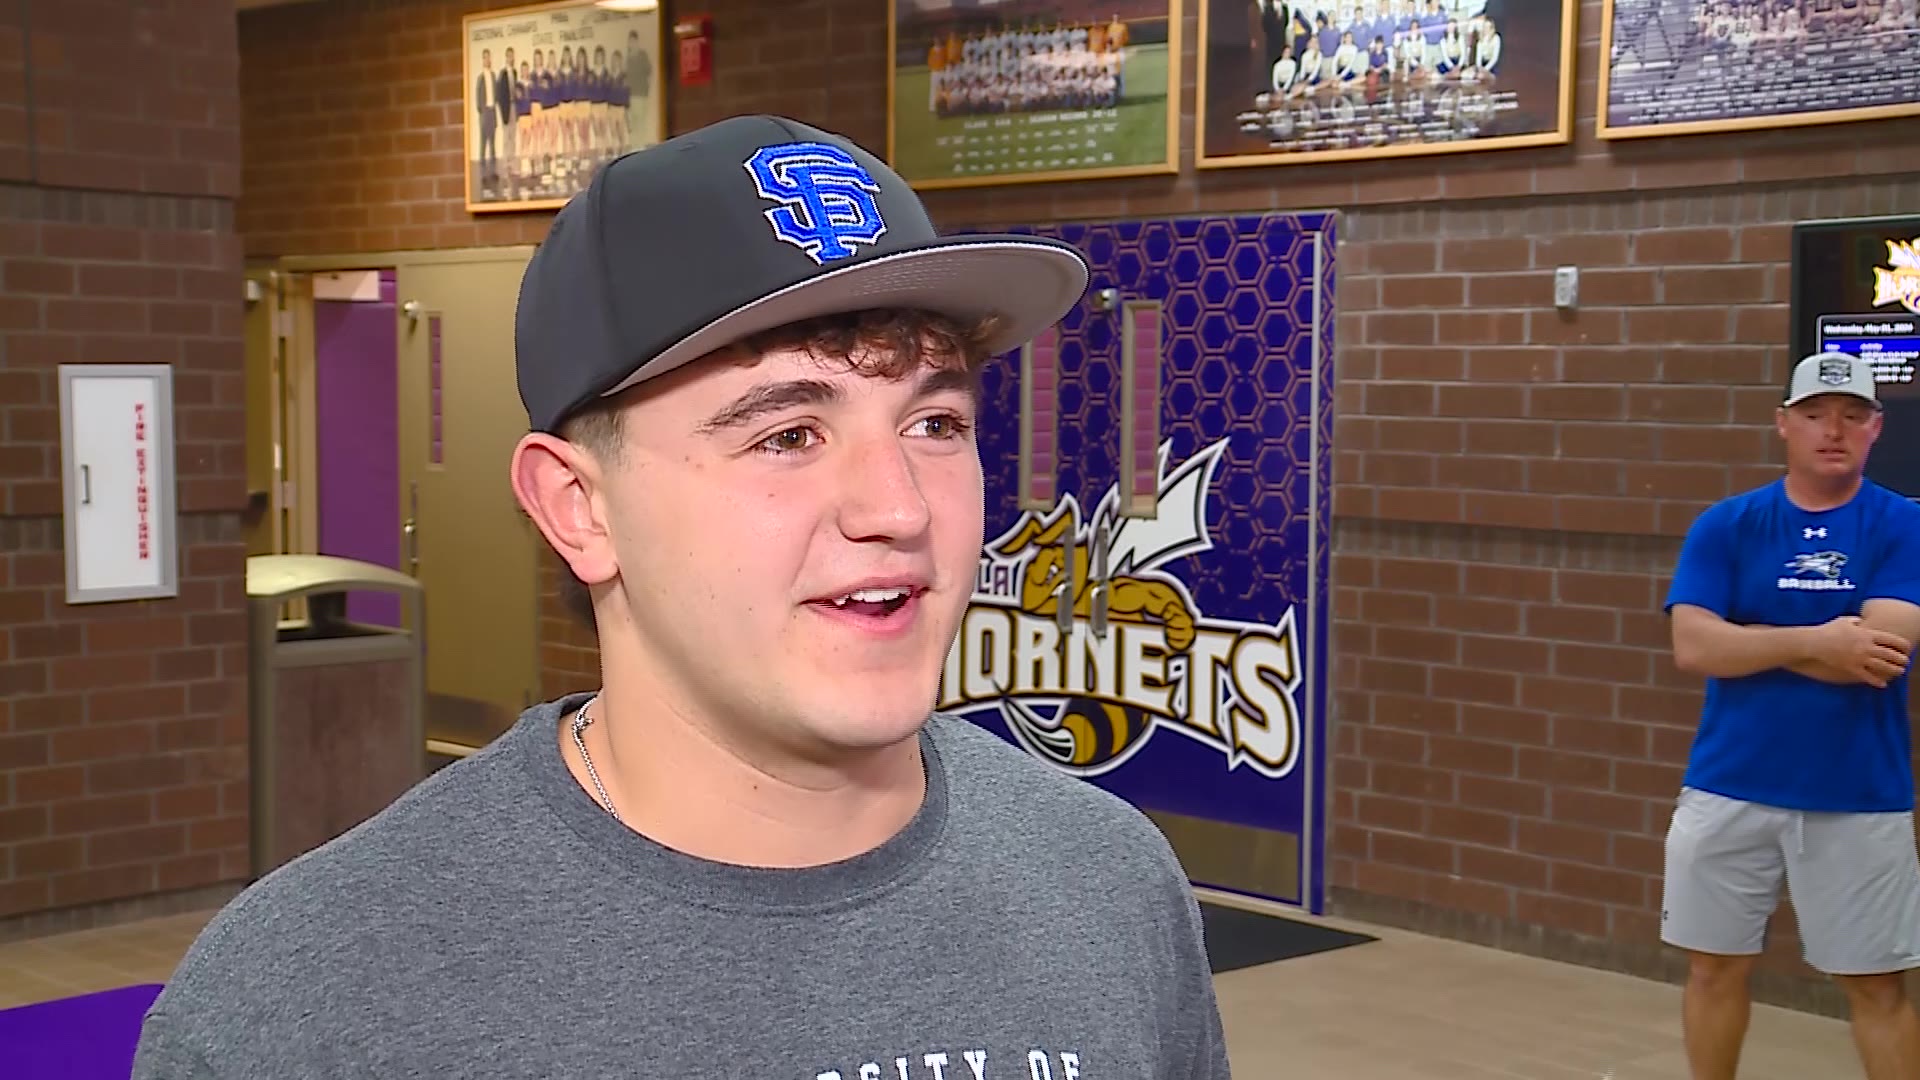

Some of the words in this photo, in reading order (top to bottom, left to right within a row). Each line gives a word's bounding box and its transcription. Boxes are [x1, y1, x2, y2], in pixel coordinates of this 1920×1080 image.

[135, 403, 145, 441] FIRE
[136, 448, 149, 560] EXTINGUISHER
[1777, 578, 1857, 591] BASEBALL
[815, 1050, 988, 1080] ITY
[1027, 1050, 1081, 1080] OF
